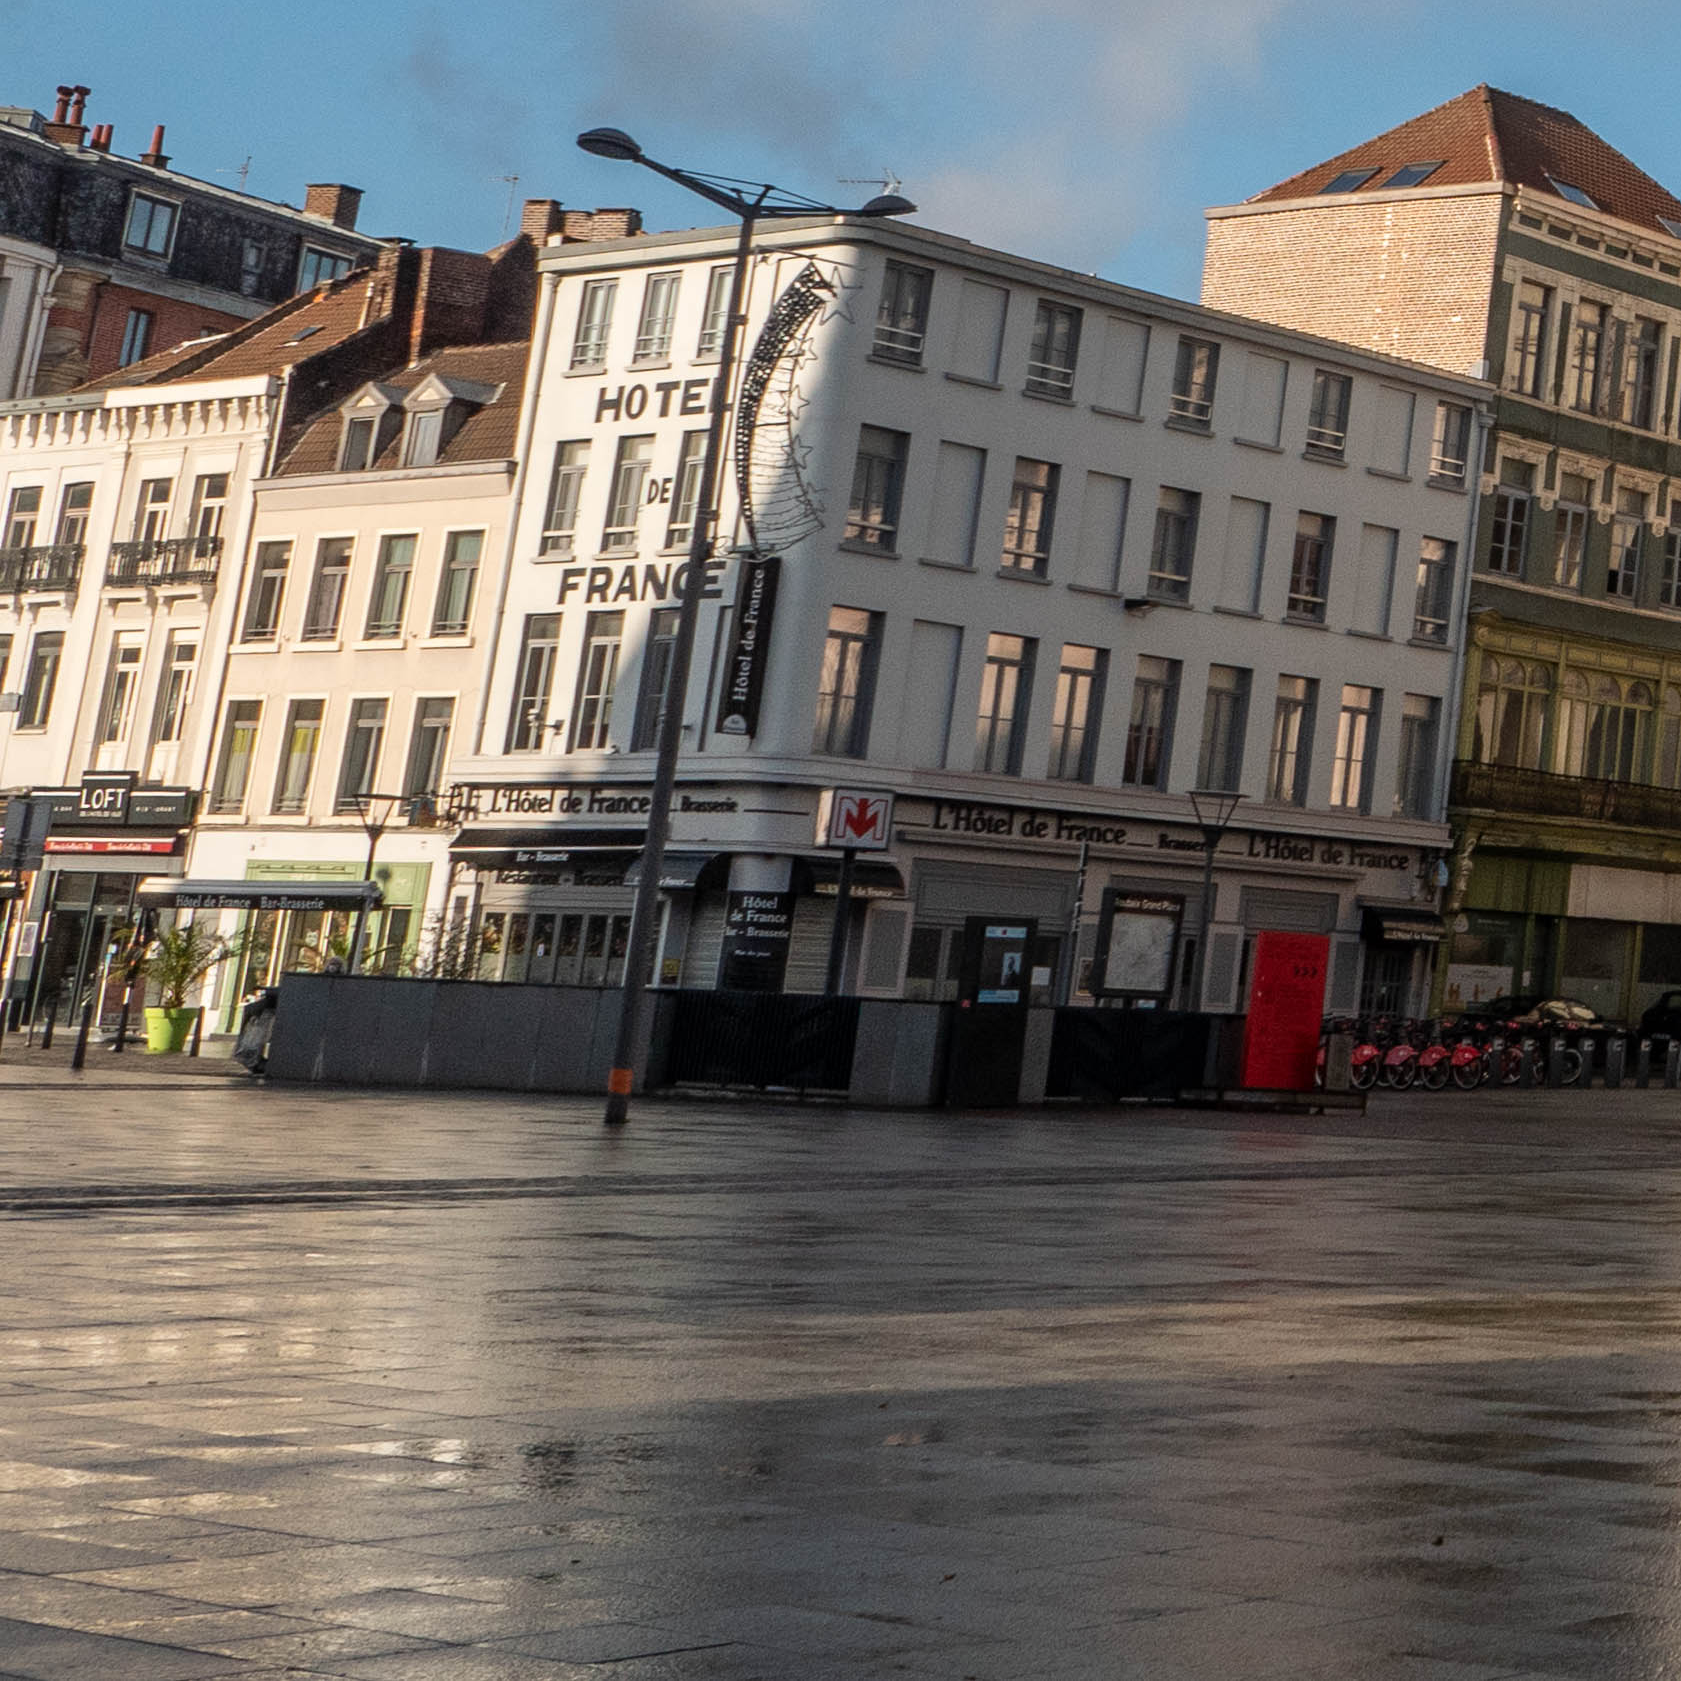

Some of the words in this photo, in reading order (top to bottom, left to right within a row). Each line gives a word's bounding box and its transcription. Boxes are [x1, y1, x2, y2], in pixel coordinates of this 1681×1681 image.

[647, 477, 674, 505] DE
[556, 561, 727, 605] FRANCE
[744, 569, 766, 625] France
[740, 630, 757, 651] de
[732, 655, 753, 702] Hôtel
[80, 788, 127, 810] LOFT
[490, 788, 552, 814] L'Hôtel
[560, 787, 583, 813] de
[587, 789, 651, 814] France
[680, 795, 739, 813] Brasserie
[932, 801, 1014, 836] L'Hôtel
[1021, 810, 1049, 839] de
[1054, 815, 1127, 845] France
[1158, 833, 1210, 853] Brasser
[1247, 832, 1314, 863] L'Hôtel
[1320, 841, 1344, 865] de
[1347, 844, 1410, 870] France
[176, 894, 201, 907] Hôtel
[203, 895, 216, 908] de
[218, 895, 251, 909] France
[742, 896, 778, 909] Hôtel
